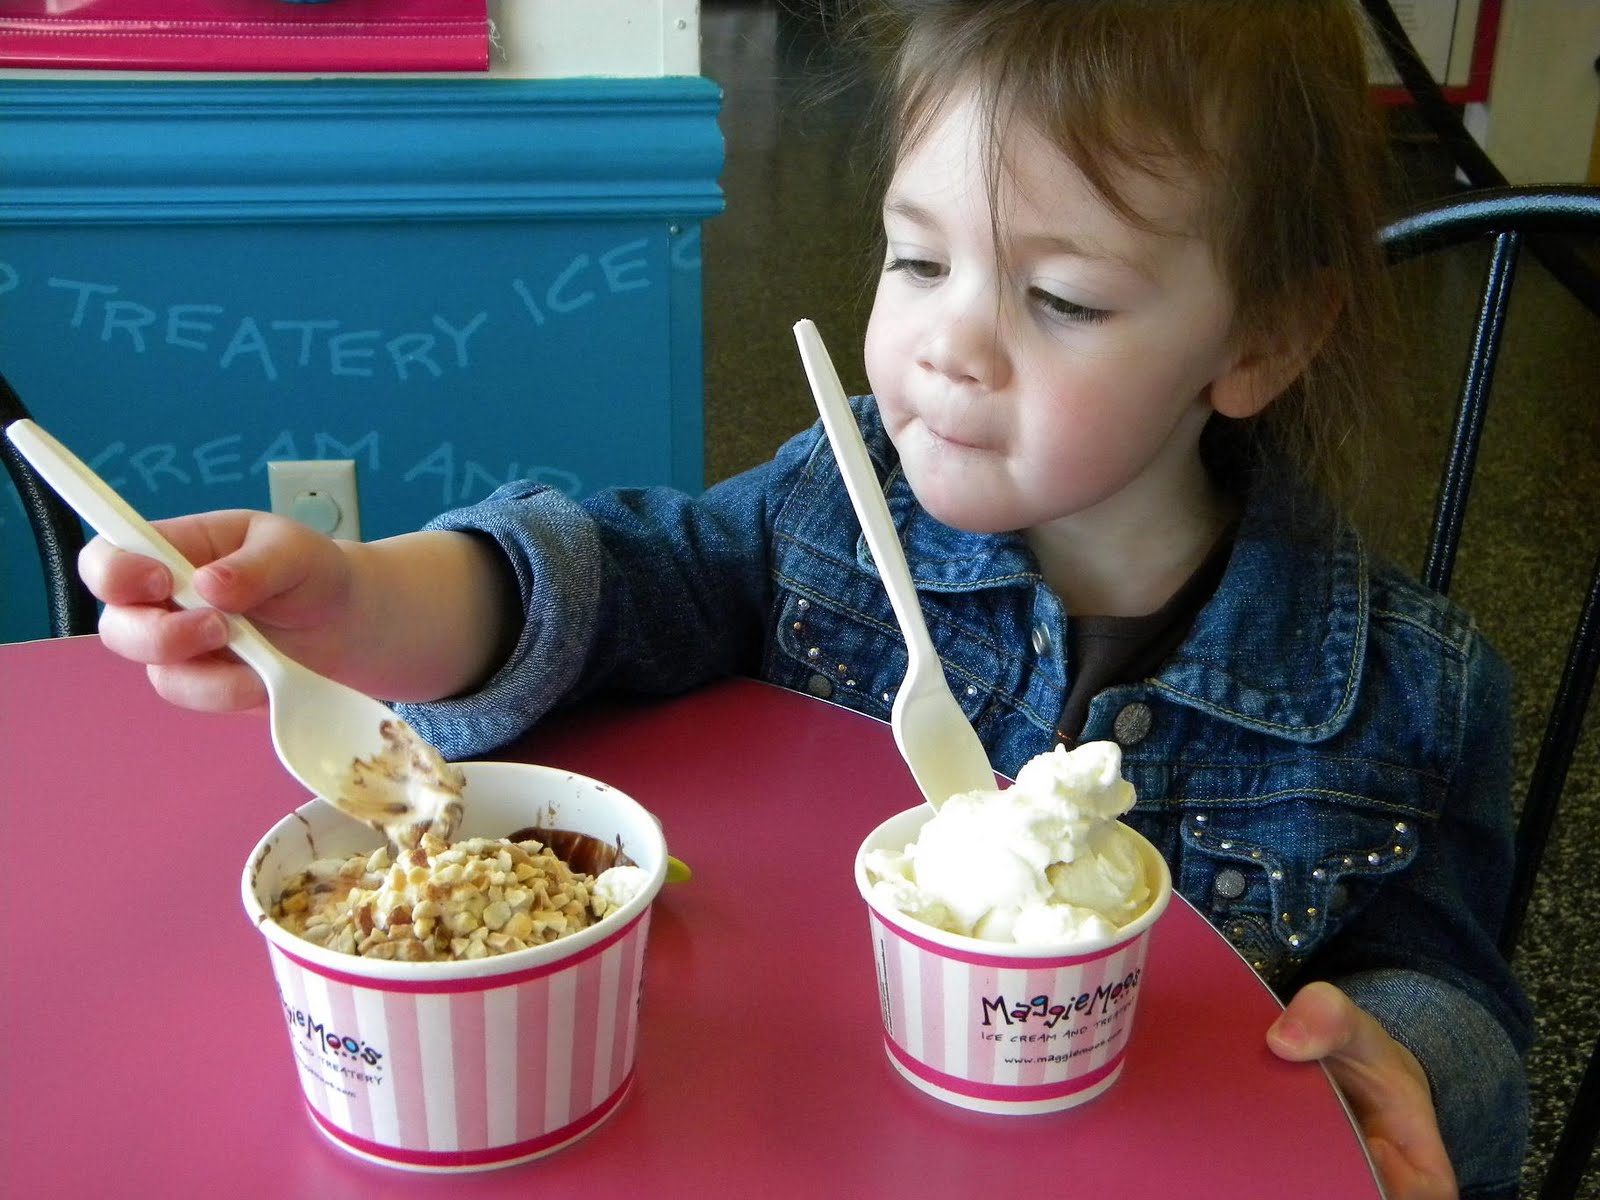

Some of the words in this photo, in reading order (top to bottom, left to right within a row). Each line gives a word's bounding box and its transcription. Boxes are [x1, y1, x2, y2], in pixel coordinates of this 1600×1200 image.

[48, 277, 487, 381] TREATERY
[512, 239, 652, 326] ICE
[403, 442, 583, 505] AND
[980, 1031, 1004, 1042] ICE
[1009, 1033, 1057, 1043] CREAM
[1062, 1026, 1088, 1039] AND
